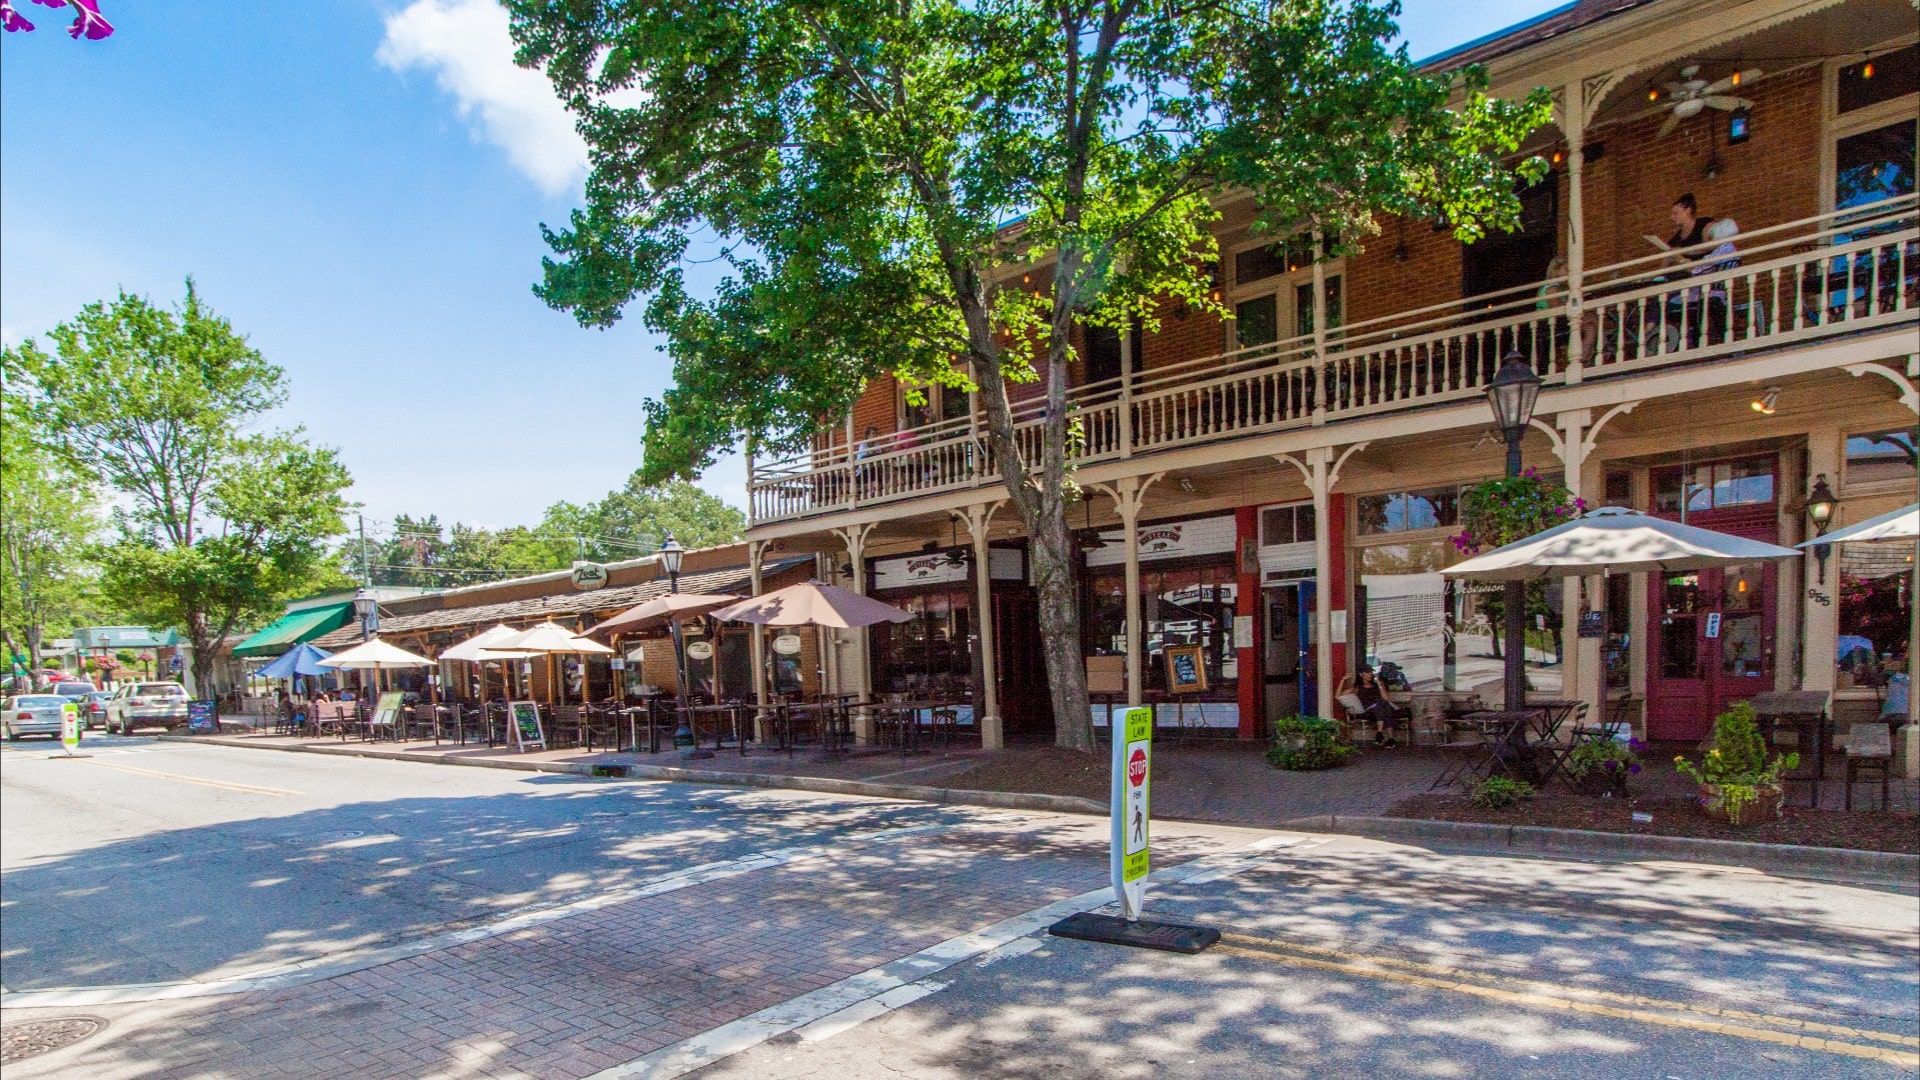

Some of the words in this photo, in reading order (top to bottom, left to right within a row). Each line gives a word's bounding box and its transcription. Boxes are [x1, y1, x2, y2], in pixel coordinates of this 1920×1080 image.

[1808, 588, 1831, 607] 955
[1131, 712, 1148, 725] STATE
[1133, 726, 1146, 738] LAW
[1130, 759, 1147, 777] STOP
